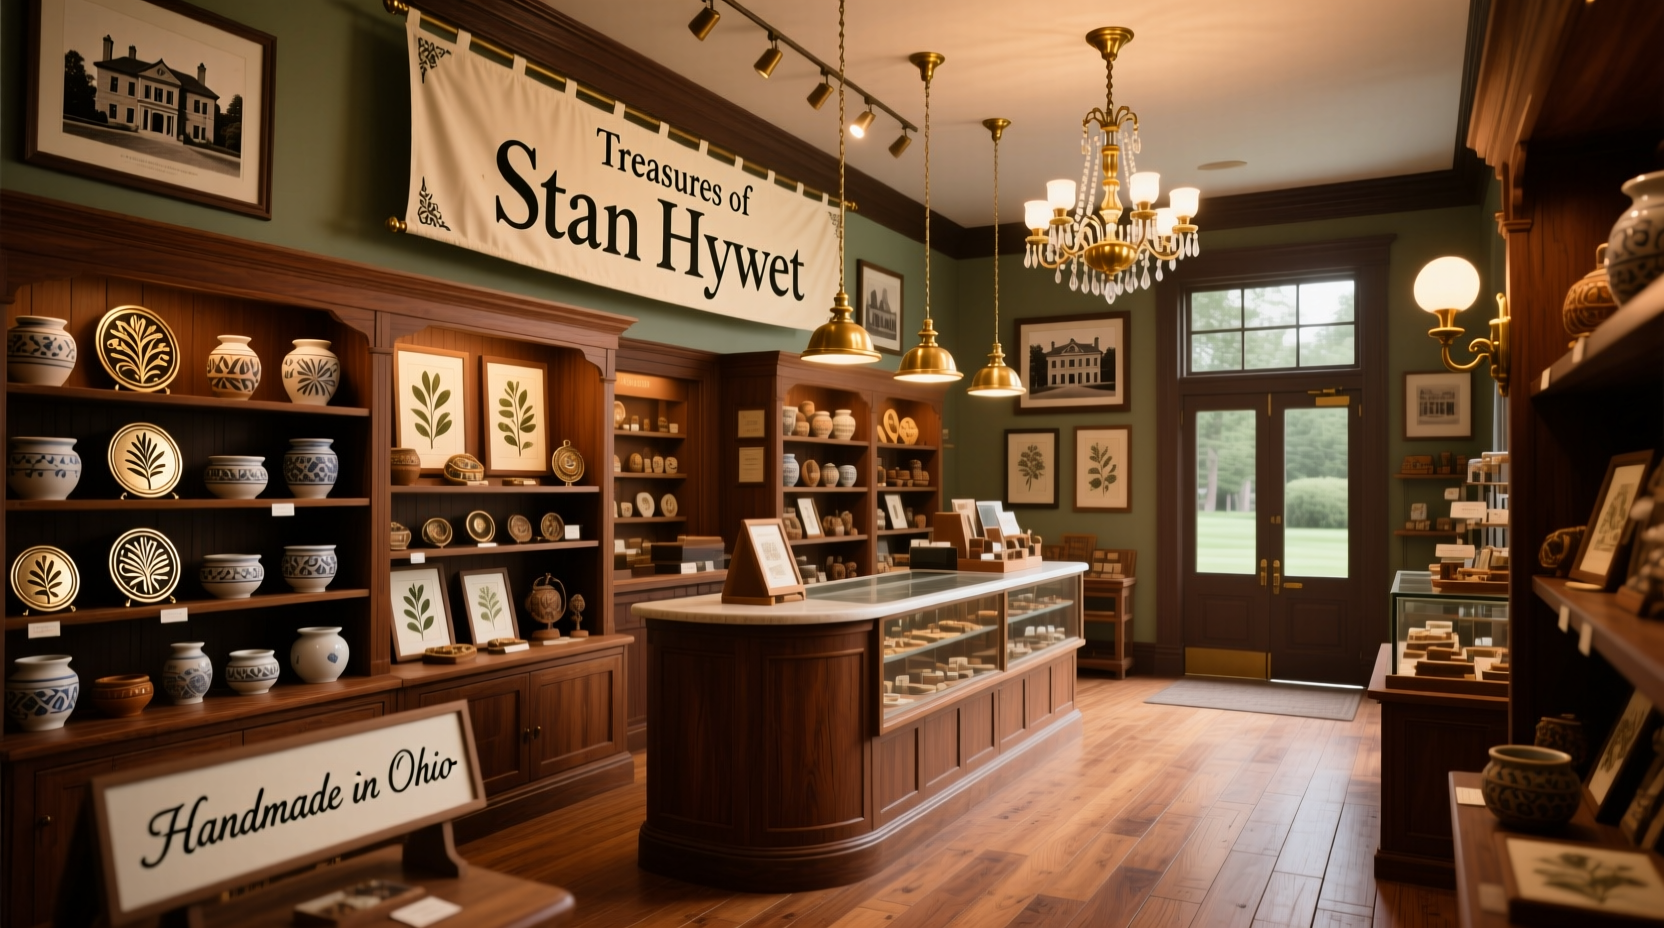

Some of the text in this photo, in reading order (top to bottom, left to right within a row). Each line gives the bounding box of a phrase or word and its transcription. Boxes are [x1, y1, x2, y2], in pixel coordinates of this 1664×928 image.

[495, 139, 805, 302] Stan Hywet
[596, 127, 754, 216] Treasures of
[140, 746, 458, 870] Handmade in Ohio
